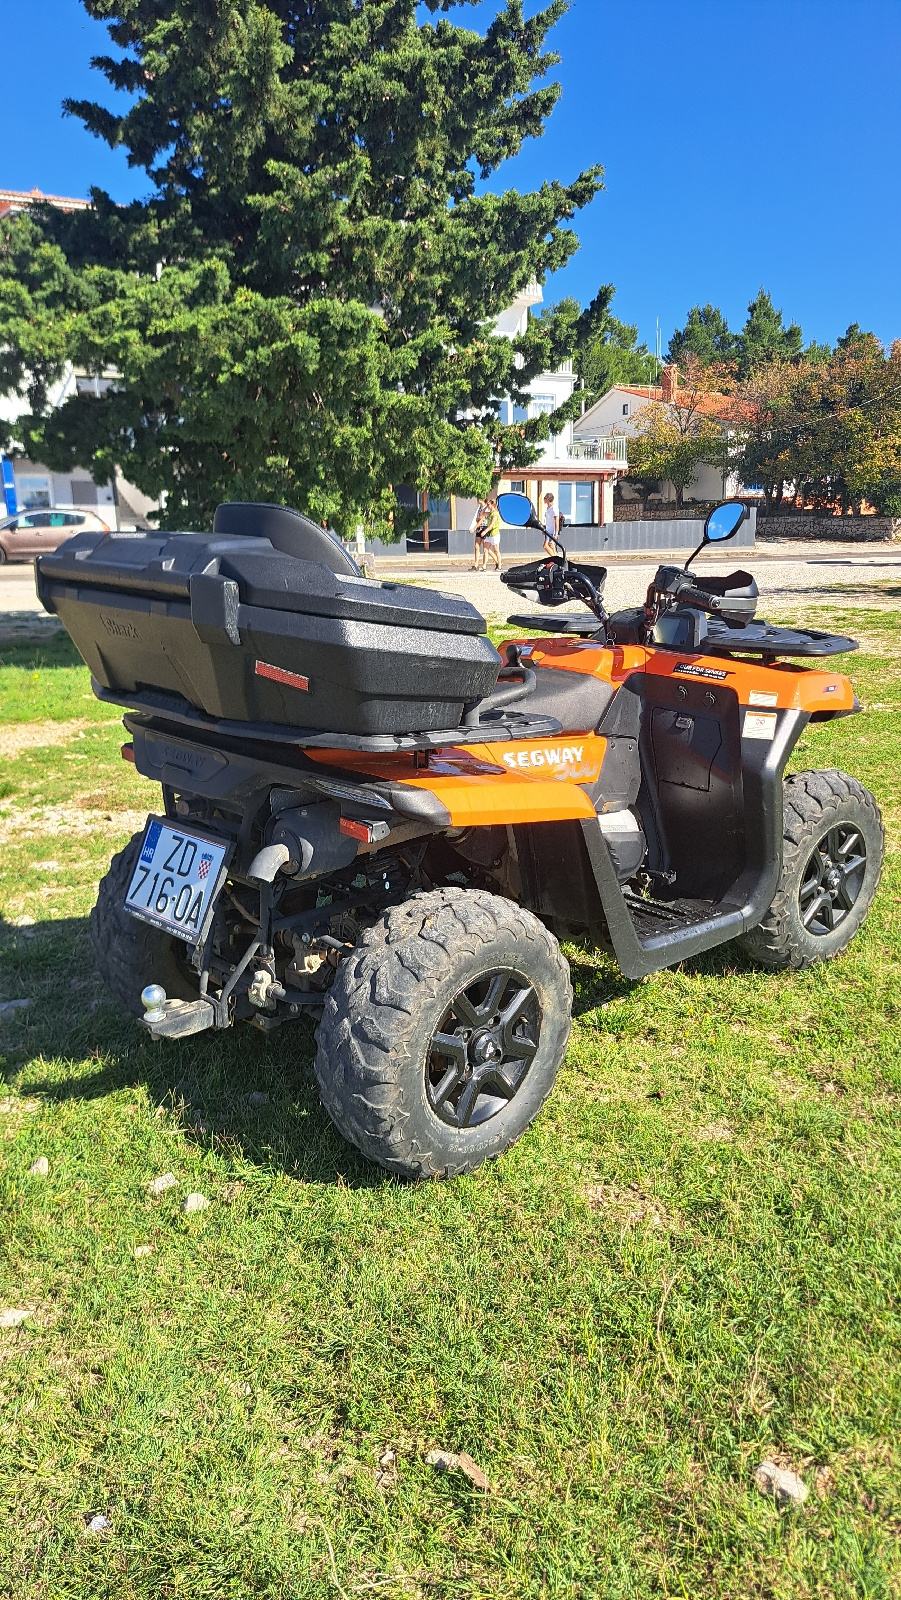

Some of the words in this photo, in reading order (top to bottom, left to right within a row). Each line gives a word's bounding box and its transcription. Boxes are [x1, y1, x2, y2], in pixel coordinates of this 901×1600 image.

[503, 746, 583, 768] SEGWAY
[142, 845, 155, 859] HR
[162, 834, 198, 877] ZD
